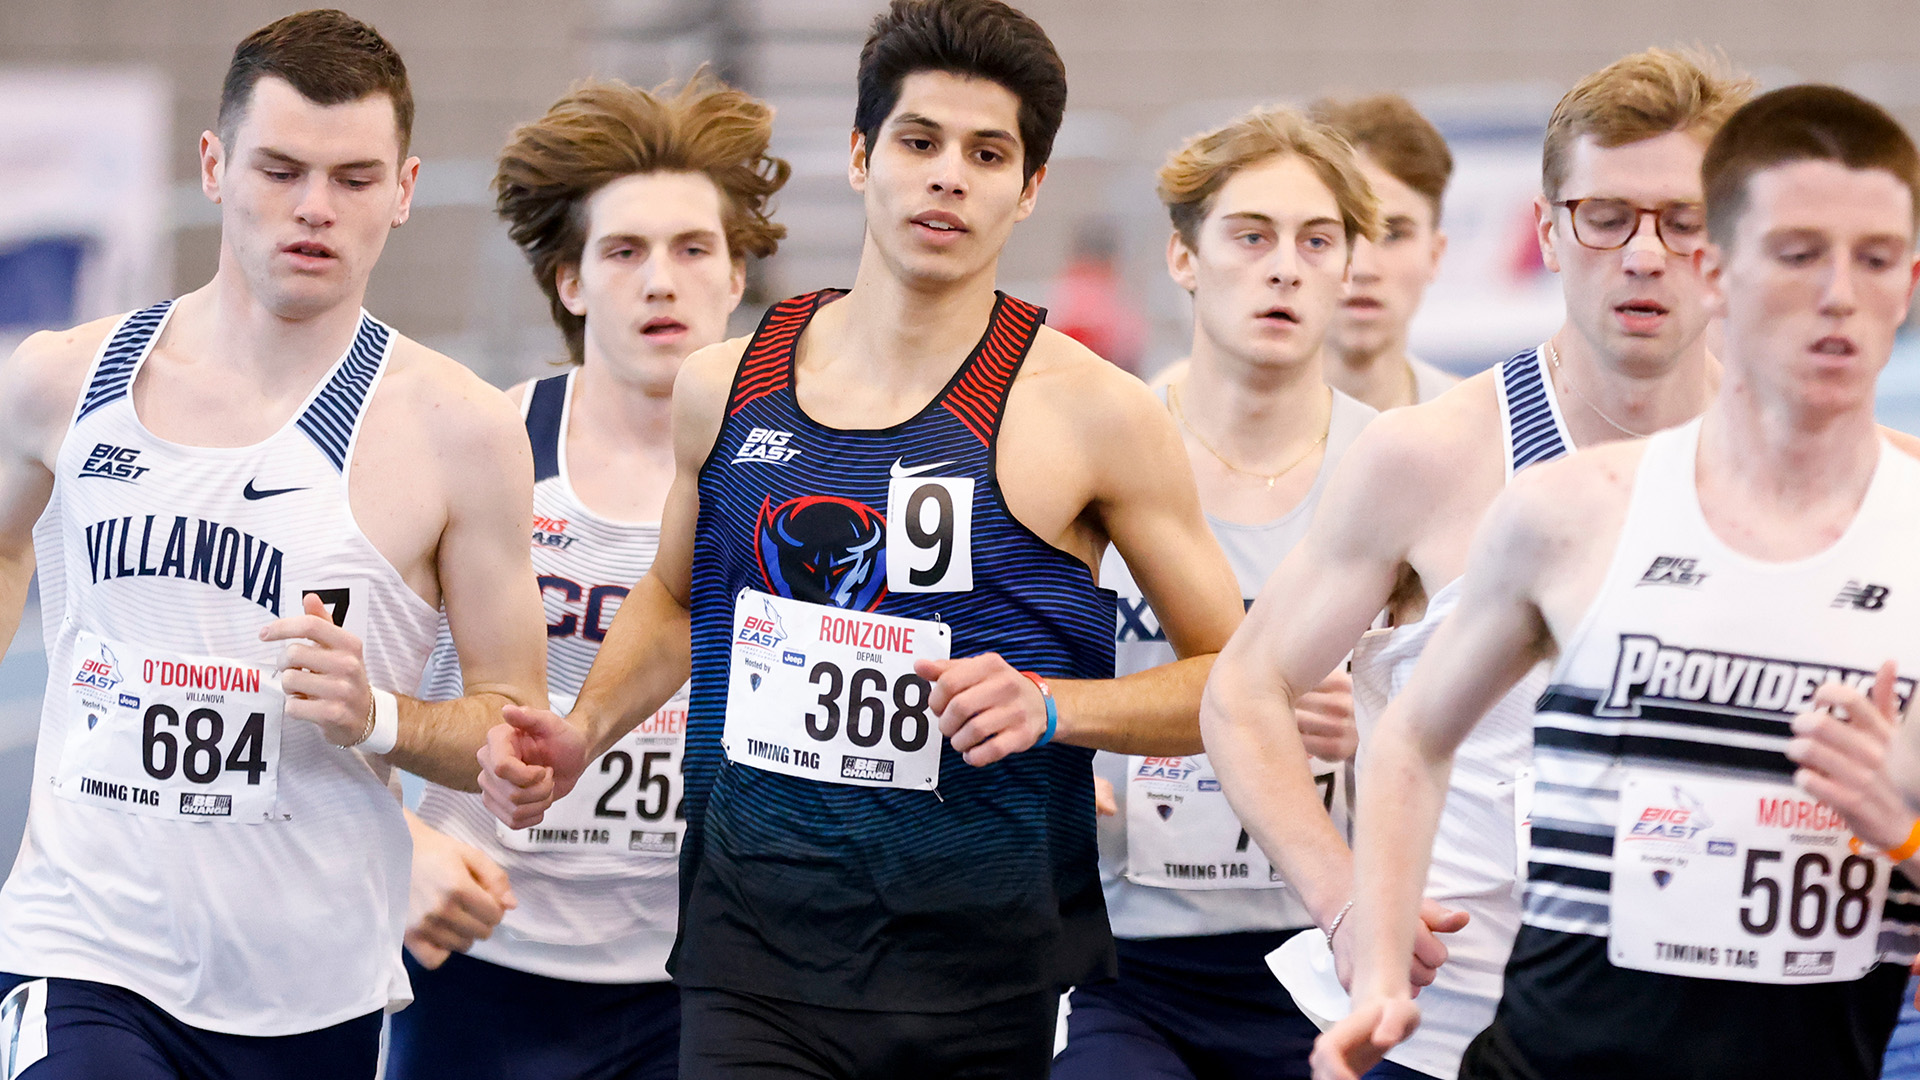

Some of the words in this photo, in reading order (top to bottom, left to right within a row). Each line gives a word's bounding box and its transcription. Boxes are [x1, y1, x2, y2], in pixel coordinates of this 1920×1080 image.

[745, 427, 794, 446] BIG
[90, 443, 141, 463] BIG
[736, 443, 802, 463] EAST
[82, 458, 150, 480] EAST
[532, 532, 579, 549] AST
[904, 483, 954, 587] 9
[86, 514, 284, 619] VILLANOVA
[1650, 556, 1698, 572] BIG
[1641, 570, 1710, 586] EAST
[744, 616, 775, 633] BIG
[739, 628, 782, 648] EAST
[819, 615, 915, 654] RONZONE
[82, 658, 112, 676] BIG
[784, 653, 803, 666] Jeep
[856, 651, 884, 664] DEPAUL
[76, 670, 119, 690] EAST
[143, 658, 260, 694] O'DONOVAN
[186, 692, 225, 704] VILLANOVA
[805, 661, 932, 753] 368
[142, 704, 267, 785] 684
[747, 738, 789, 764] TIMING
[793, 749, 820, 770] TAG
[842, 768, 891, 780] CHANGE
[1138, 766, 1193, 780] EAST
[80, 776, 128, 801] TIMING
[132, 786, 160, 807] TAG
[181, 804, 230, 815] CHANGE
[1640, 807, 1692, 824] BIG
[1757, 798, 1847, 832] MORGA
[528, 828, 578, 844] TIMING
[583, 829, 610, 844] TAG
[1631, 822, 1700, 839] EAST
[1164, 863, 1216, 879] TIMING
[1221, 864, 1248, 879] TAG
[1739, 848, 1875, 938] 568
[1655, 942, 1718, 965] TIMING
[1725, 948, 1759, 968] TAG
